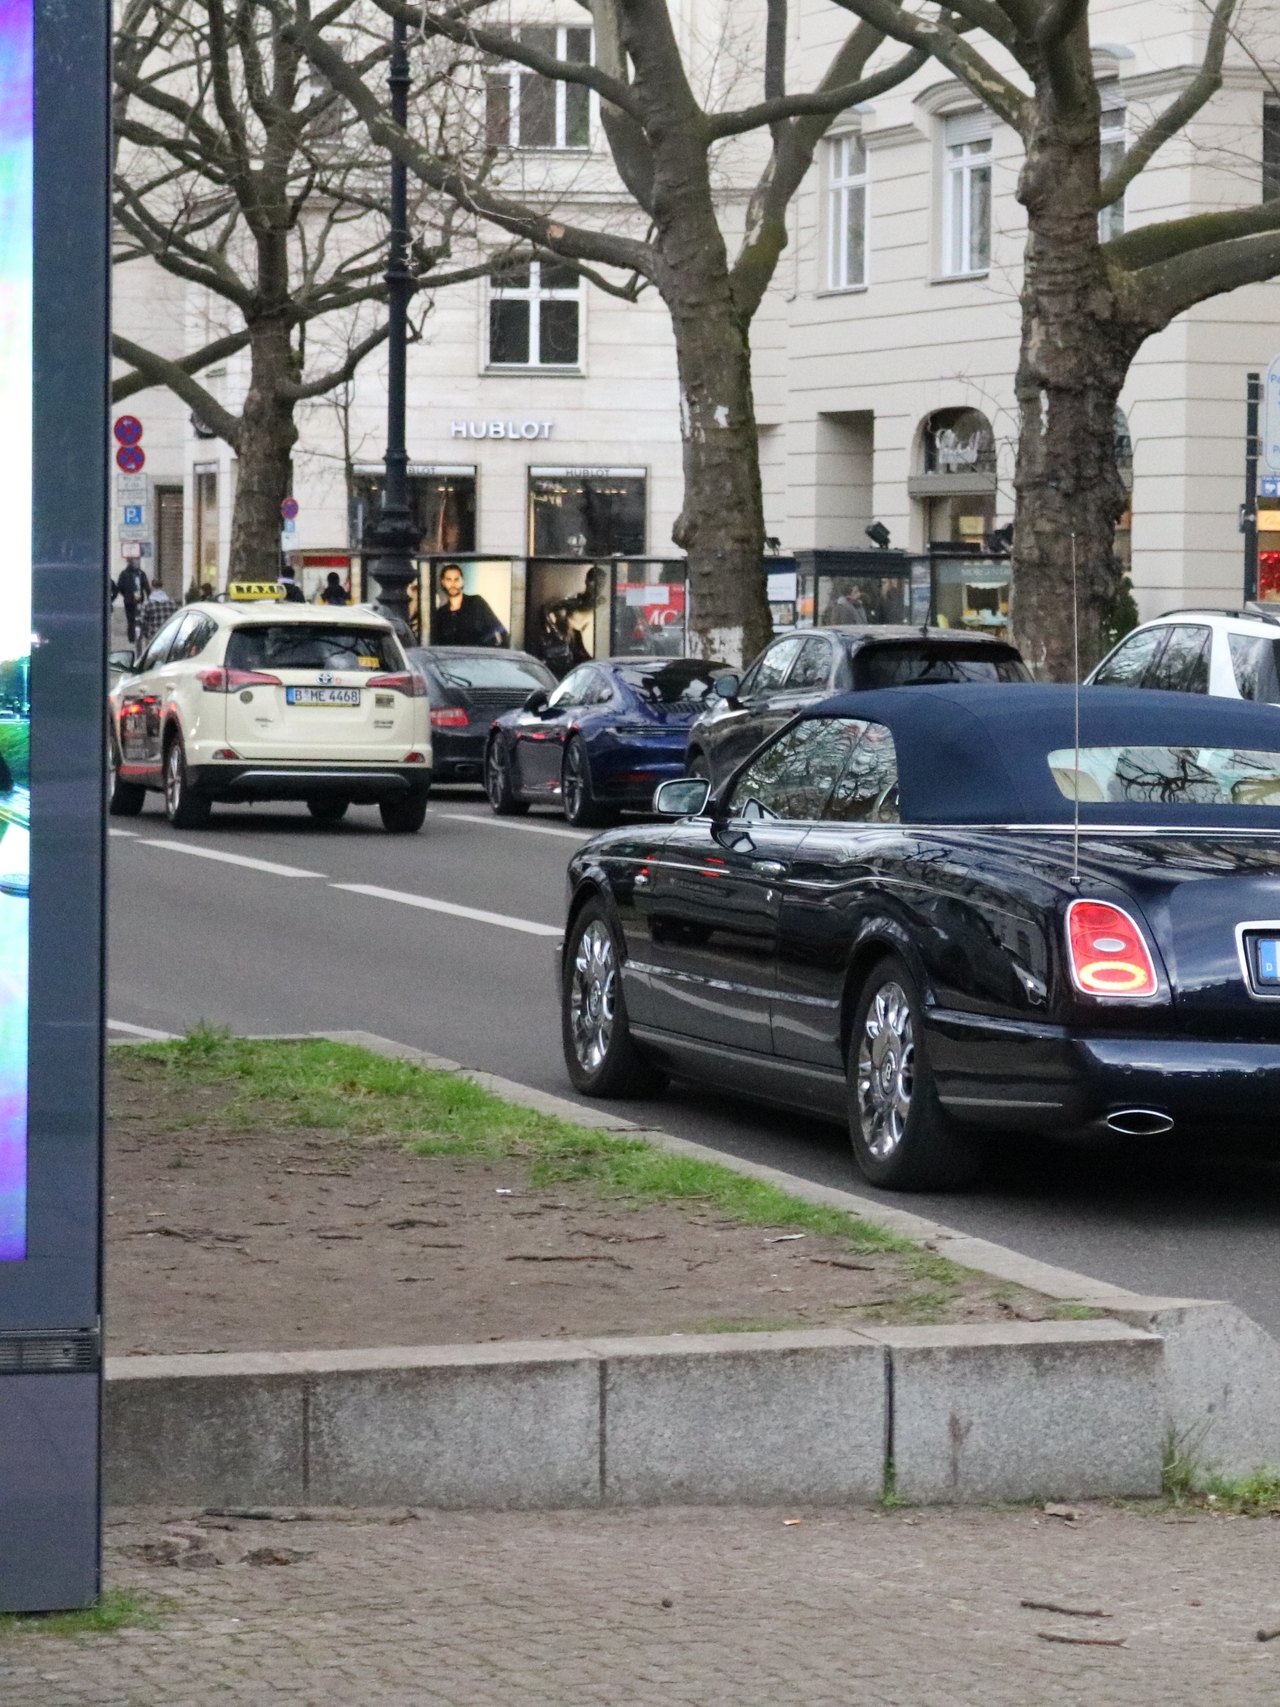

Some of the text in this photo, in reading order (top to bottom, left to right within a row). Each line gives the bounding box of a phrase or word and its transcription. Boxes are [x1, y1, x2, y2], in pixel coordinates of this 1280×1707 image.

[450, 420, 555, 440] HUBLOT
[407, 466, 436, 475] BLOT
[565, 468, 610, 477] HUBLOT
[241, 585, 278, 595] TAXI
[294, 689, 358, 703] B ME 4468
